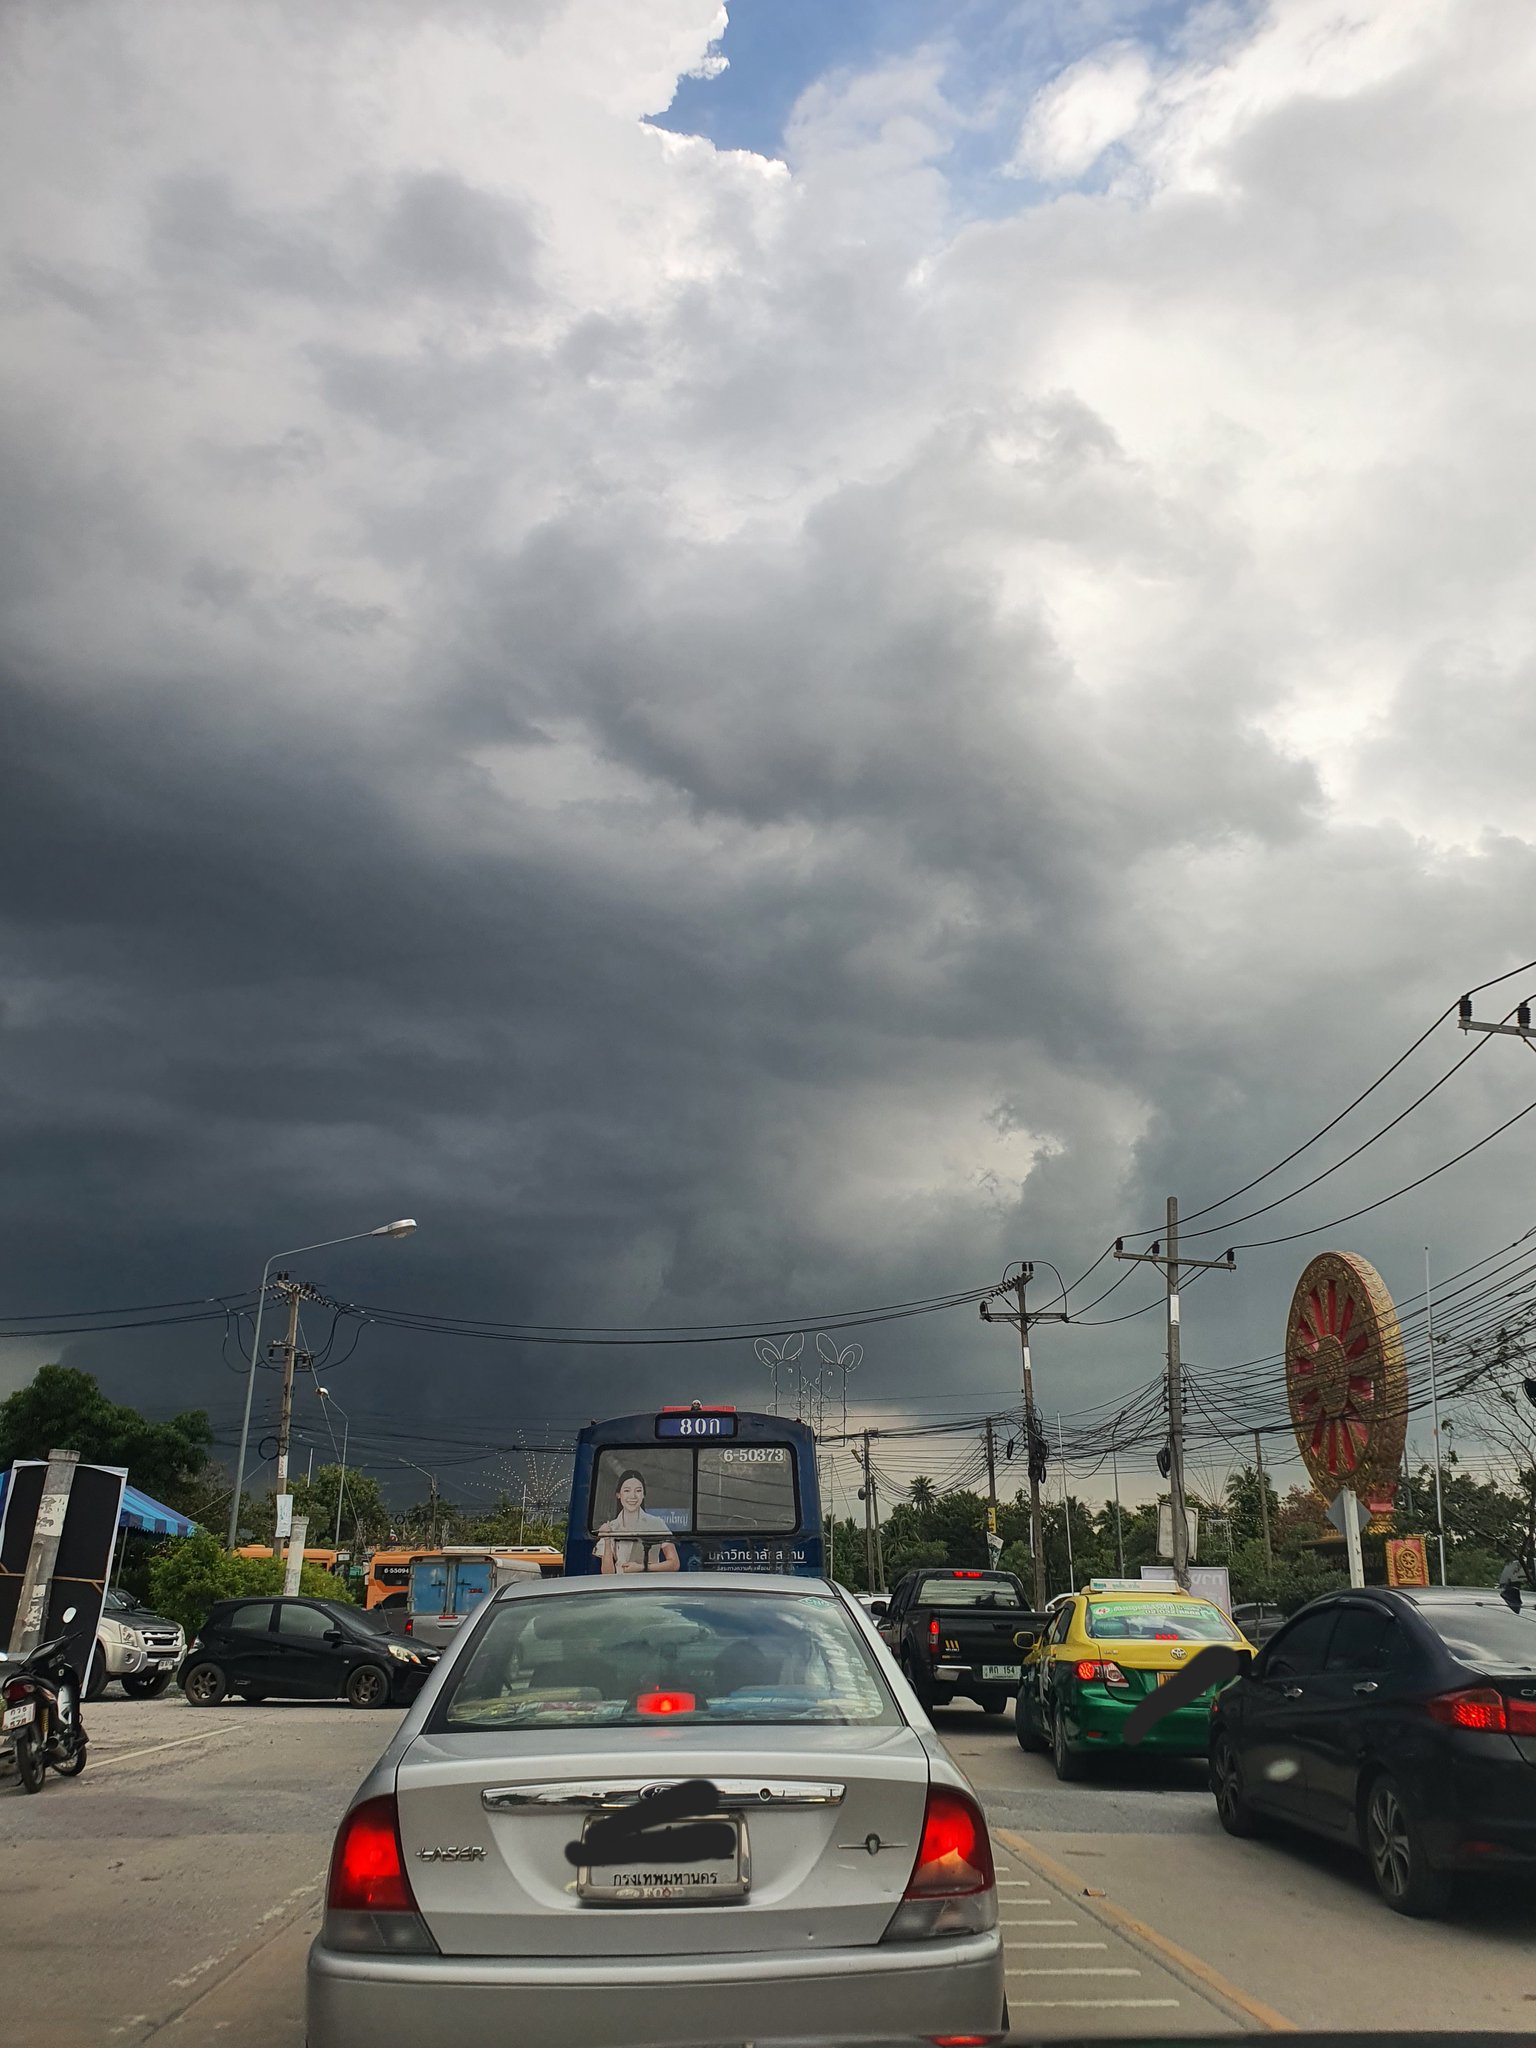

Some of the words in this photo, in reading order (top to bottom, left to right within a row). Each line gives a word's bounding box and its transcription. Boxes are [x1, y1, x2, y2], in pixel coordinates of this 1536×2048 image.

[680, 1418, 720, 1435] 80ก
[723, 1449, 784, 1462] 6-50373
[1003, 1666, 1015, 1674] 154
[418, 1846, 486, 1862] LASER
